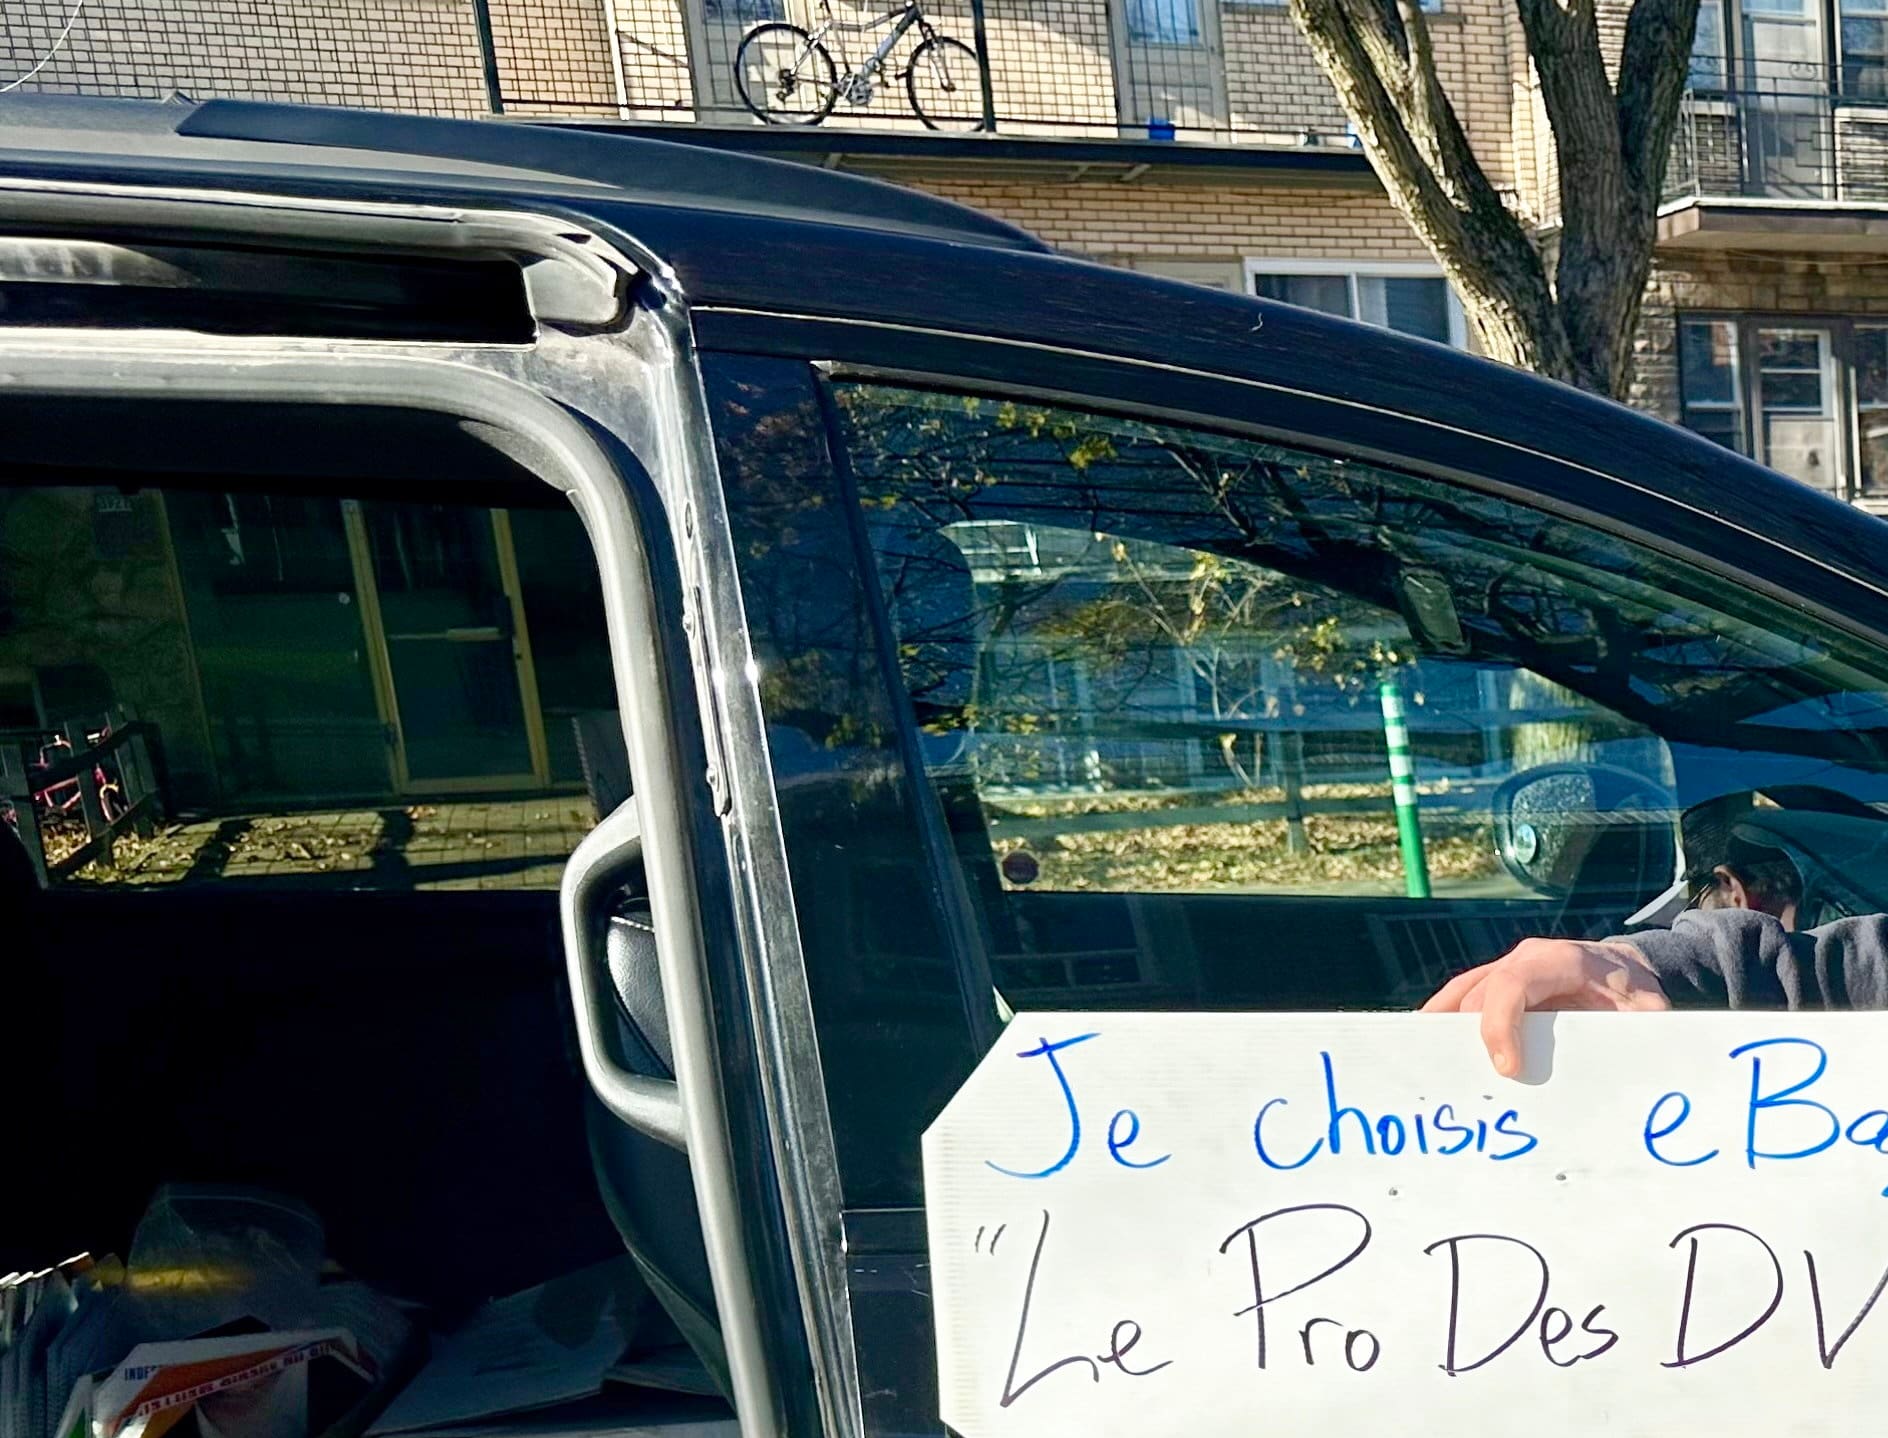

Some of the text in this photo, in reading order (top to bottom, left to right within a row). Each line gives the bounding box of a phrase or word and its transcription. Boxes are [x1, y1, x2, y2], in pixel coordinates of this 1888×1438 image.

[985, 1033, 1171, 1180] Je
[1254, 1051, 1538, 1170] choisis
[1219, 1203, 1381, 1372] Pro
[1423, 1234, 1619, 1378] Des
